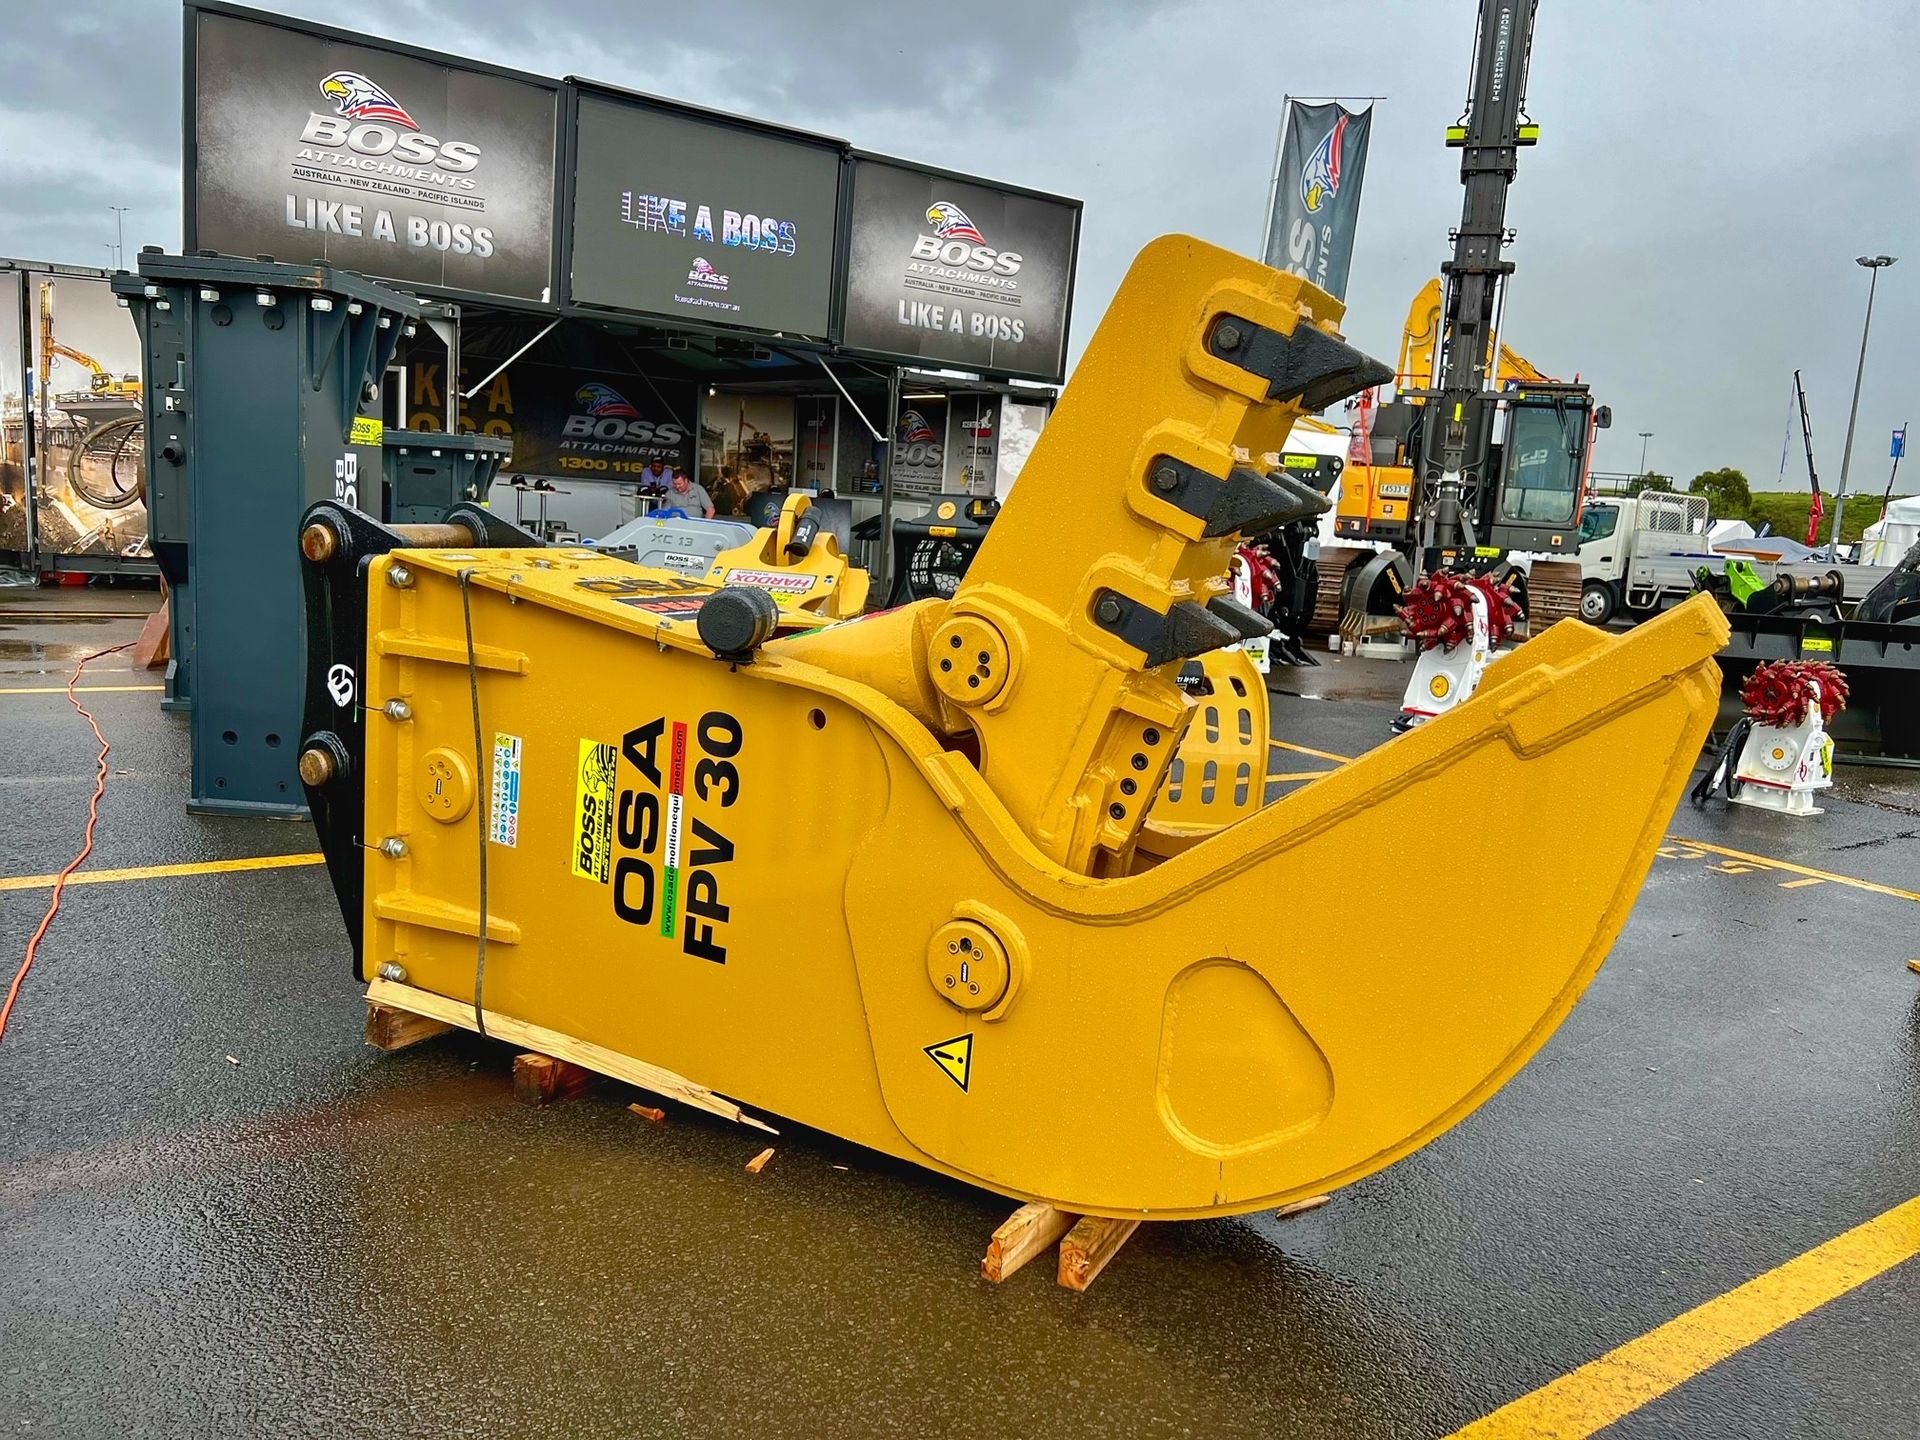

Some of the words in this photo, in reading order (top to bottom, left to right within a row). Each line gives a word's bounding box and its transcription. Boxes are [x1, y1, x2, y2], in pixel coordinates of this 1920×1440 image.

[1492, 40, 1506, 102] ATTACHMENTS
[300, 112, 482, 174] BOSS
[293, 167, 342, 183] AUSTRALIA
[350, 178, 370, 189] NEW
[372, 182, 411, 196] ZEALAND
[418, 190, 449, 203] PACIFIC
[450, 196, 486, 210] ISLANDS
[296, 148, 477, 191] ATTACHMENTS
[286, 194, 364, 238] LIKE
[372, 210, 398, 244] A
[407, 215, 496, 258] BOSS
[620, 191, 688, 238] LIKE
[693, 205, 715, 243] A
[722, 209, 797, 257] BOSS
[907, 262, 1018, 290] ATTACHMENTS
[910, 234, 1024, 277] BOSS
[688, 270, 730, 285] BOSS
[904, 278, 935, 289] AUSTRALIA
[939, 284, 951, 292] NEW
[951, 287, 976, 297] ZEALAND
[979, 291, 1000, 301] PACIFIC
[1000, 295, 1022, 304] ISLANDS
[898, 299, 945, 331] LIKE
[948, 308, 964, 334] A
[970, 312, 1025, 343] BOSS
[559, 440, 681, 458] ATTACHMENTS
[561, 414, 684, 446] BOSS
[559, 457, 608, 470] 1300
[612, 461, 644, 473] 116
[651, 533, 673, 545] XC
[679, 537, 694, 547] 13
[735, 574, 810, 588] HARDOX
[694, 711, 743, 808] 30
[580, 793, 597, 875] BOSS
[593, 798, 604, 878] ATTACHMENTS
[613, 717, 665, 926] OSA
[664, 729, 684, 934] www.osademolitionequipment.com
[683, 817, 735, 965] FPV
